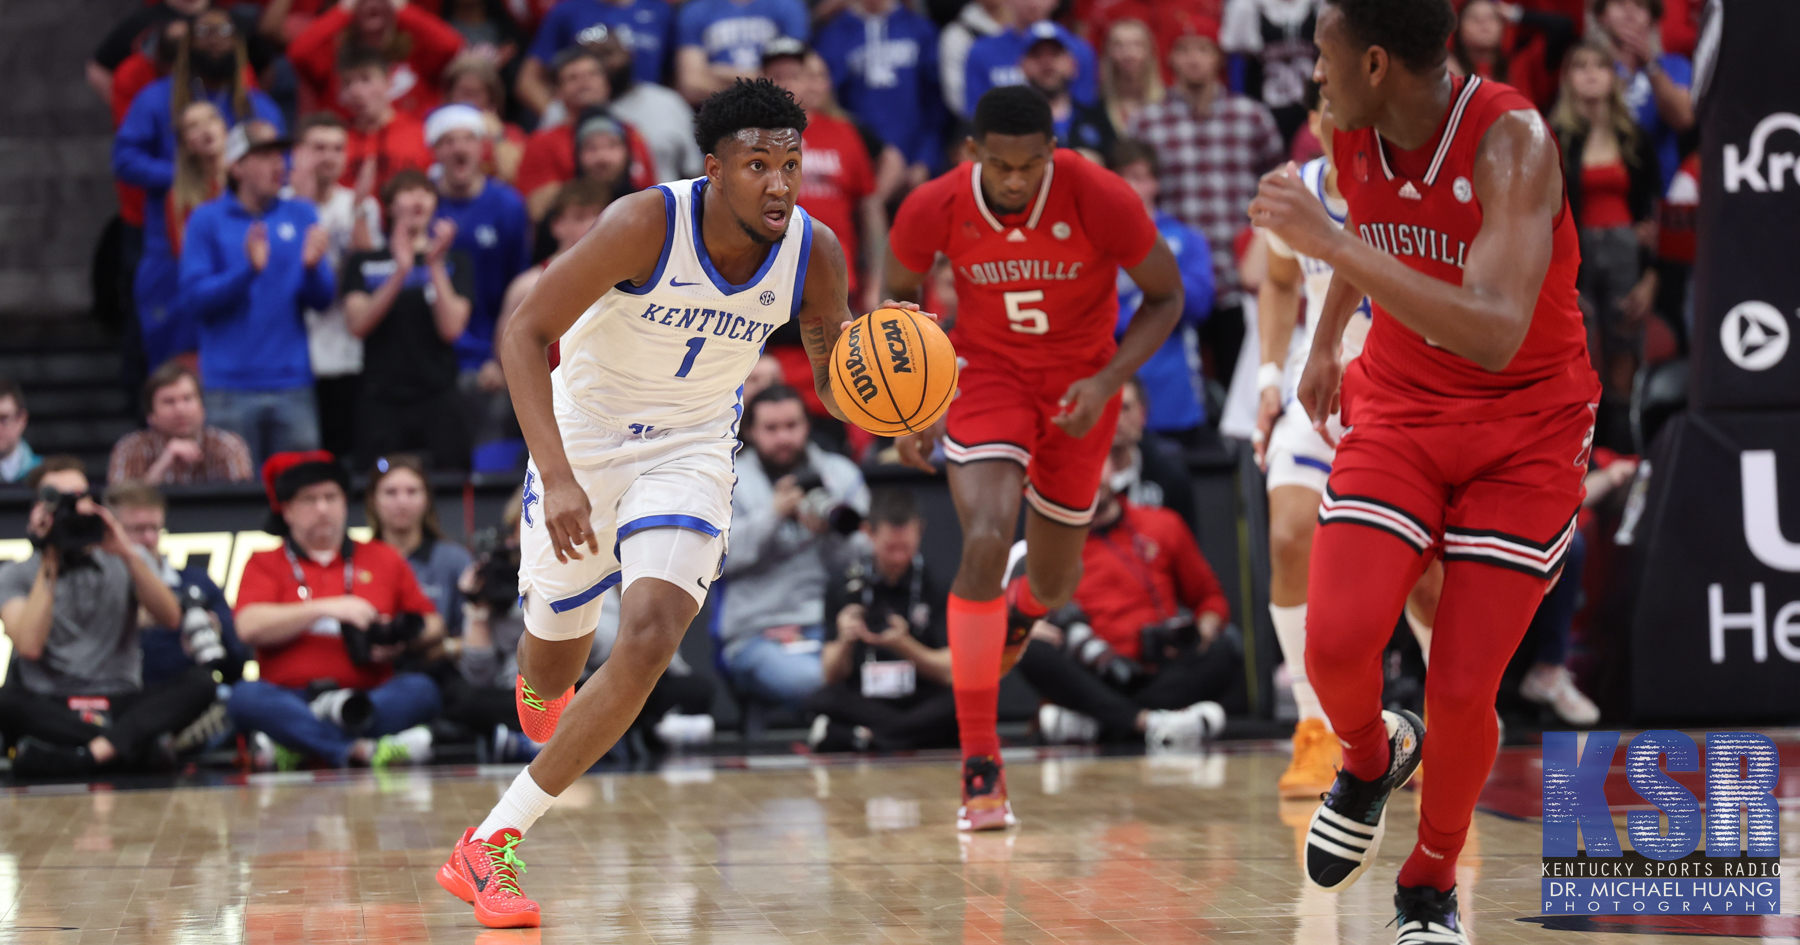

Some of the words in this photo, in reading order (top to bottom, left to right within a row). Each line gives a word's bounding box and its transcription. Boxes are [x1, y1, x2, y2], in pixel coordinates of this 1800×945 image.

[1723, 111, 1800, 193] Kr
[1359, 222, 1466, 269] OUISVILL
[960, 259, 1083, 285] LOUISVILLE
[760, 291, 775, 306] SEC
[1003, 289, 1049, 336] 5
[641, 302, 774, 343] KENTUCKY
[881, 319, 912, 373] NCAA
[674, 336, 706, 378] 1
[845, 320, 878, 404] Wilson
